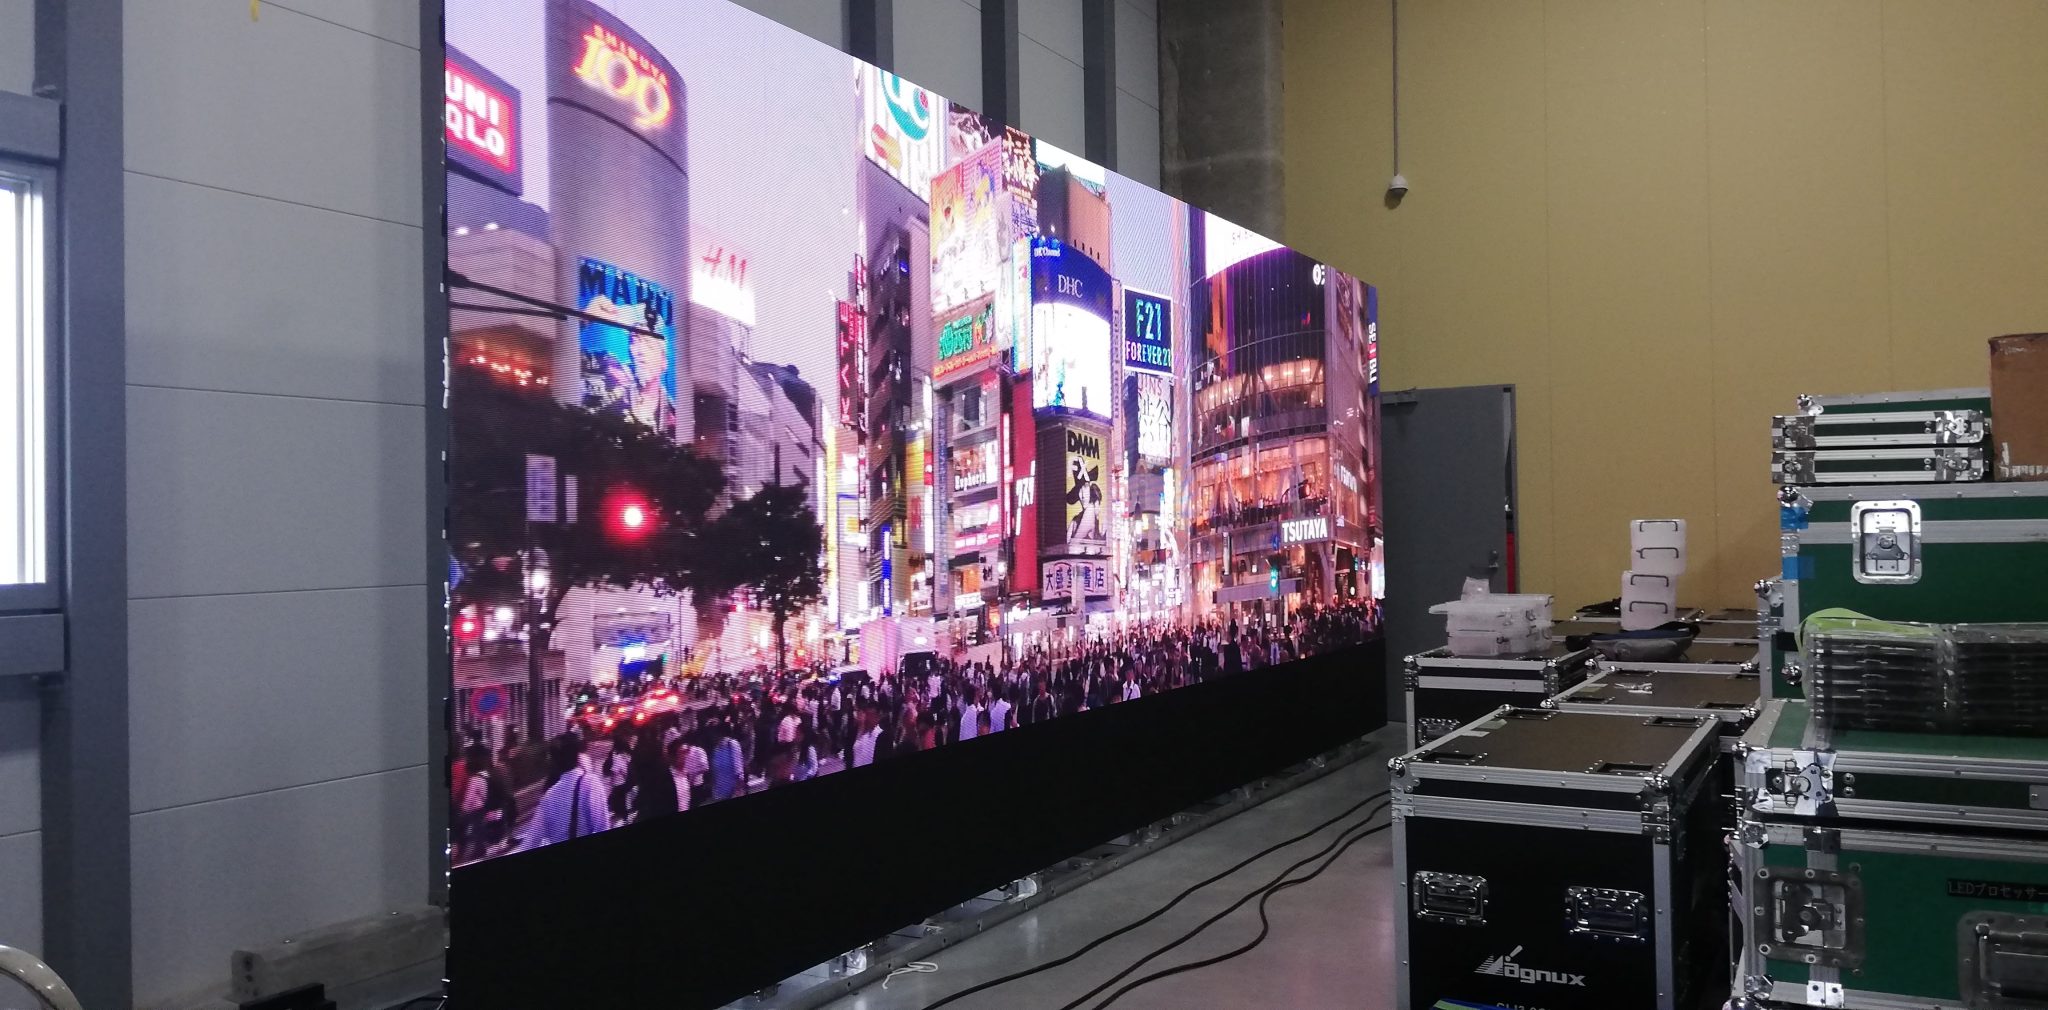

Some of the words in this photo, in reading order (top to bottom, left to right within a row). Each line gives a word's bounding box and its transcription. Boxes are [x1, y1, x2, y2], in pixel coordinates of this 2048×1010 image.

[445, 69, 499, 126] UNI
[573, 34, 671, 128] 109
[445, 103, 505, 156] QLO
[1058, 274, 1083, 298] DHC
[1135, 298, 1162, 340] F21
[1126, 341, 1162, 366] FOREVER
[1067, 430, 1100, 460] DMM
[1281, 517, 1328, 543] TSUTAYA
